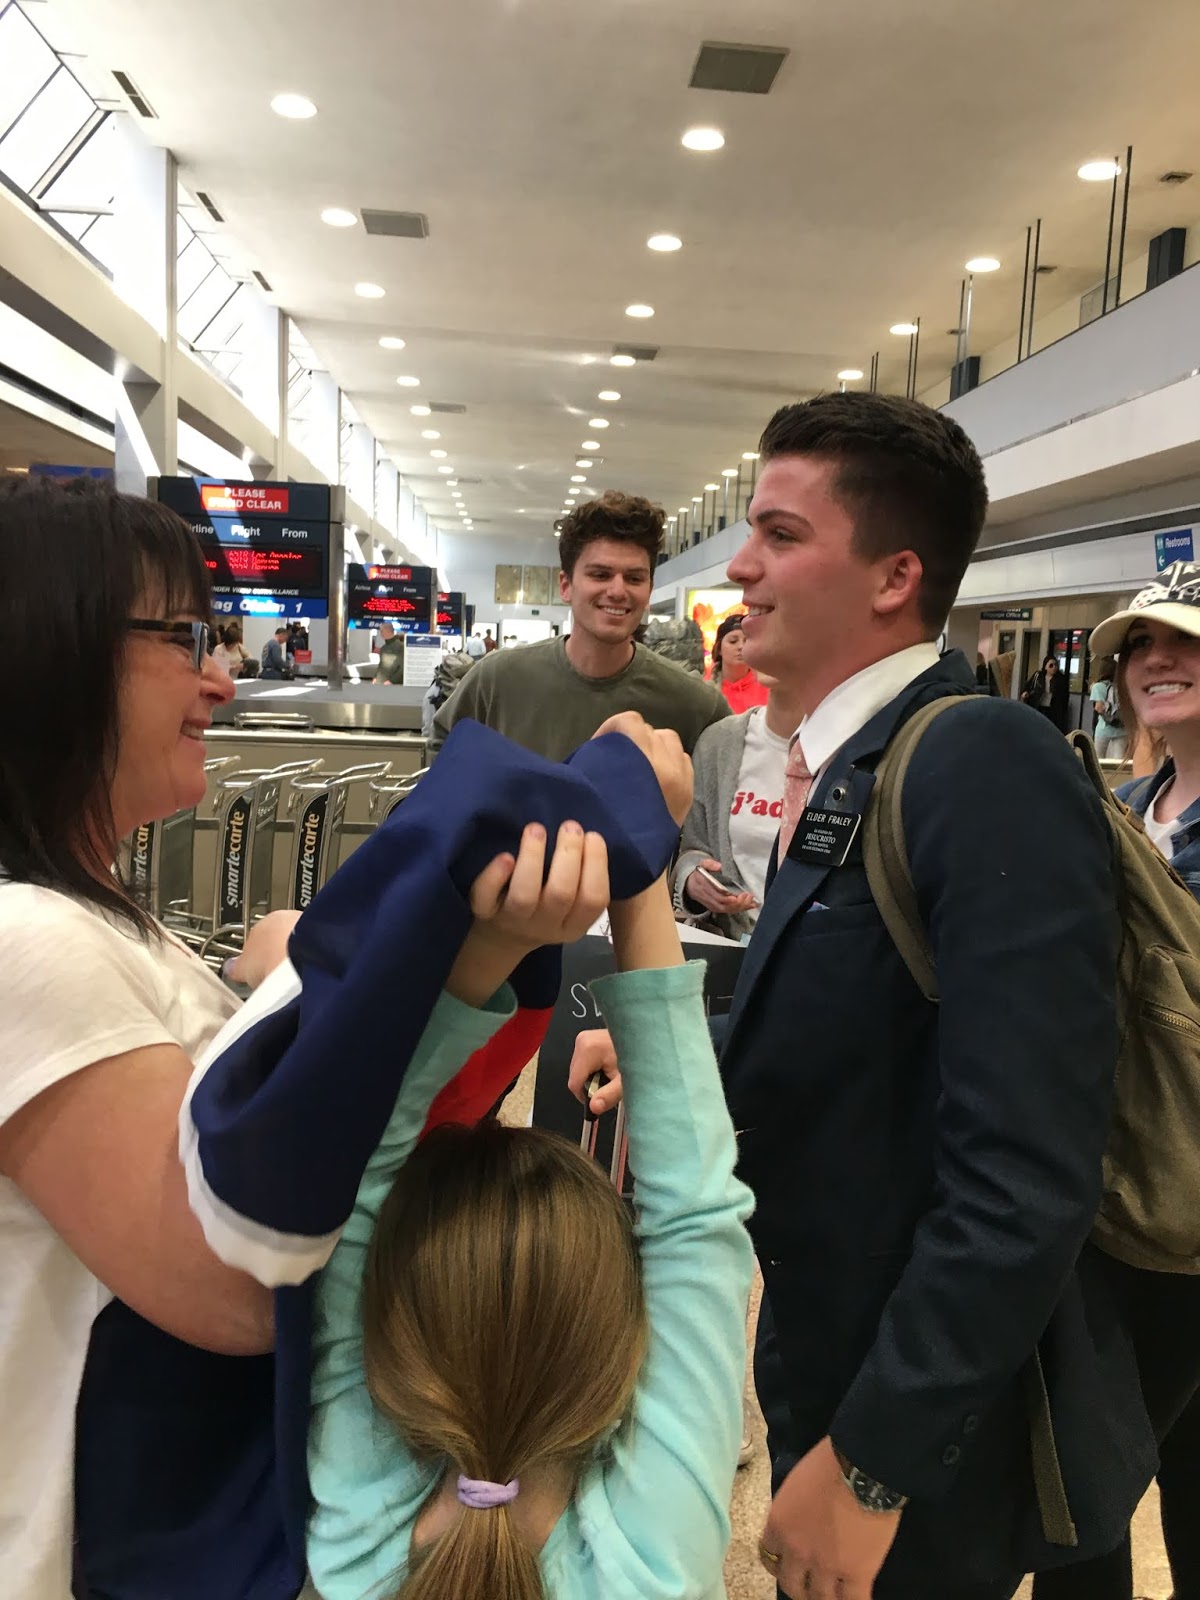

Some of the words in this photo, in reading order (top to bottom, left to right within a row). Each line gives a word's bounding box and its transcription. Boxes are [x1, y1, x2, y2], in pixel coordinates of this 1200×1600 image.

[224, 487, 266, 498] PLEASE
[246, 500, 281, 510] CLEAR
[281, 528, 308, 538] From
[1165, 536, 1191, 548] Restrooms
[295, 602, 303, 614] 1
[806, 811, 827, 823] ELDER
[827, 815, 852, 827] FRALEY
[804, 833, 837, 844] JESUCRISTO
[226, 810, 246, 908] smartecarte
[300, 812, 320, 908] smartecarte
